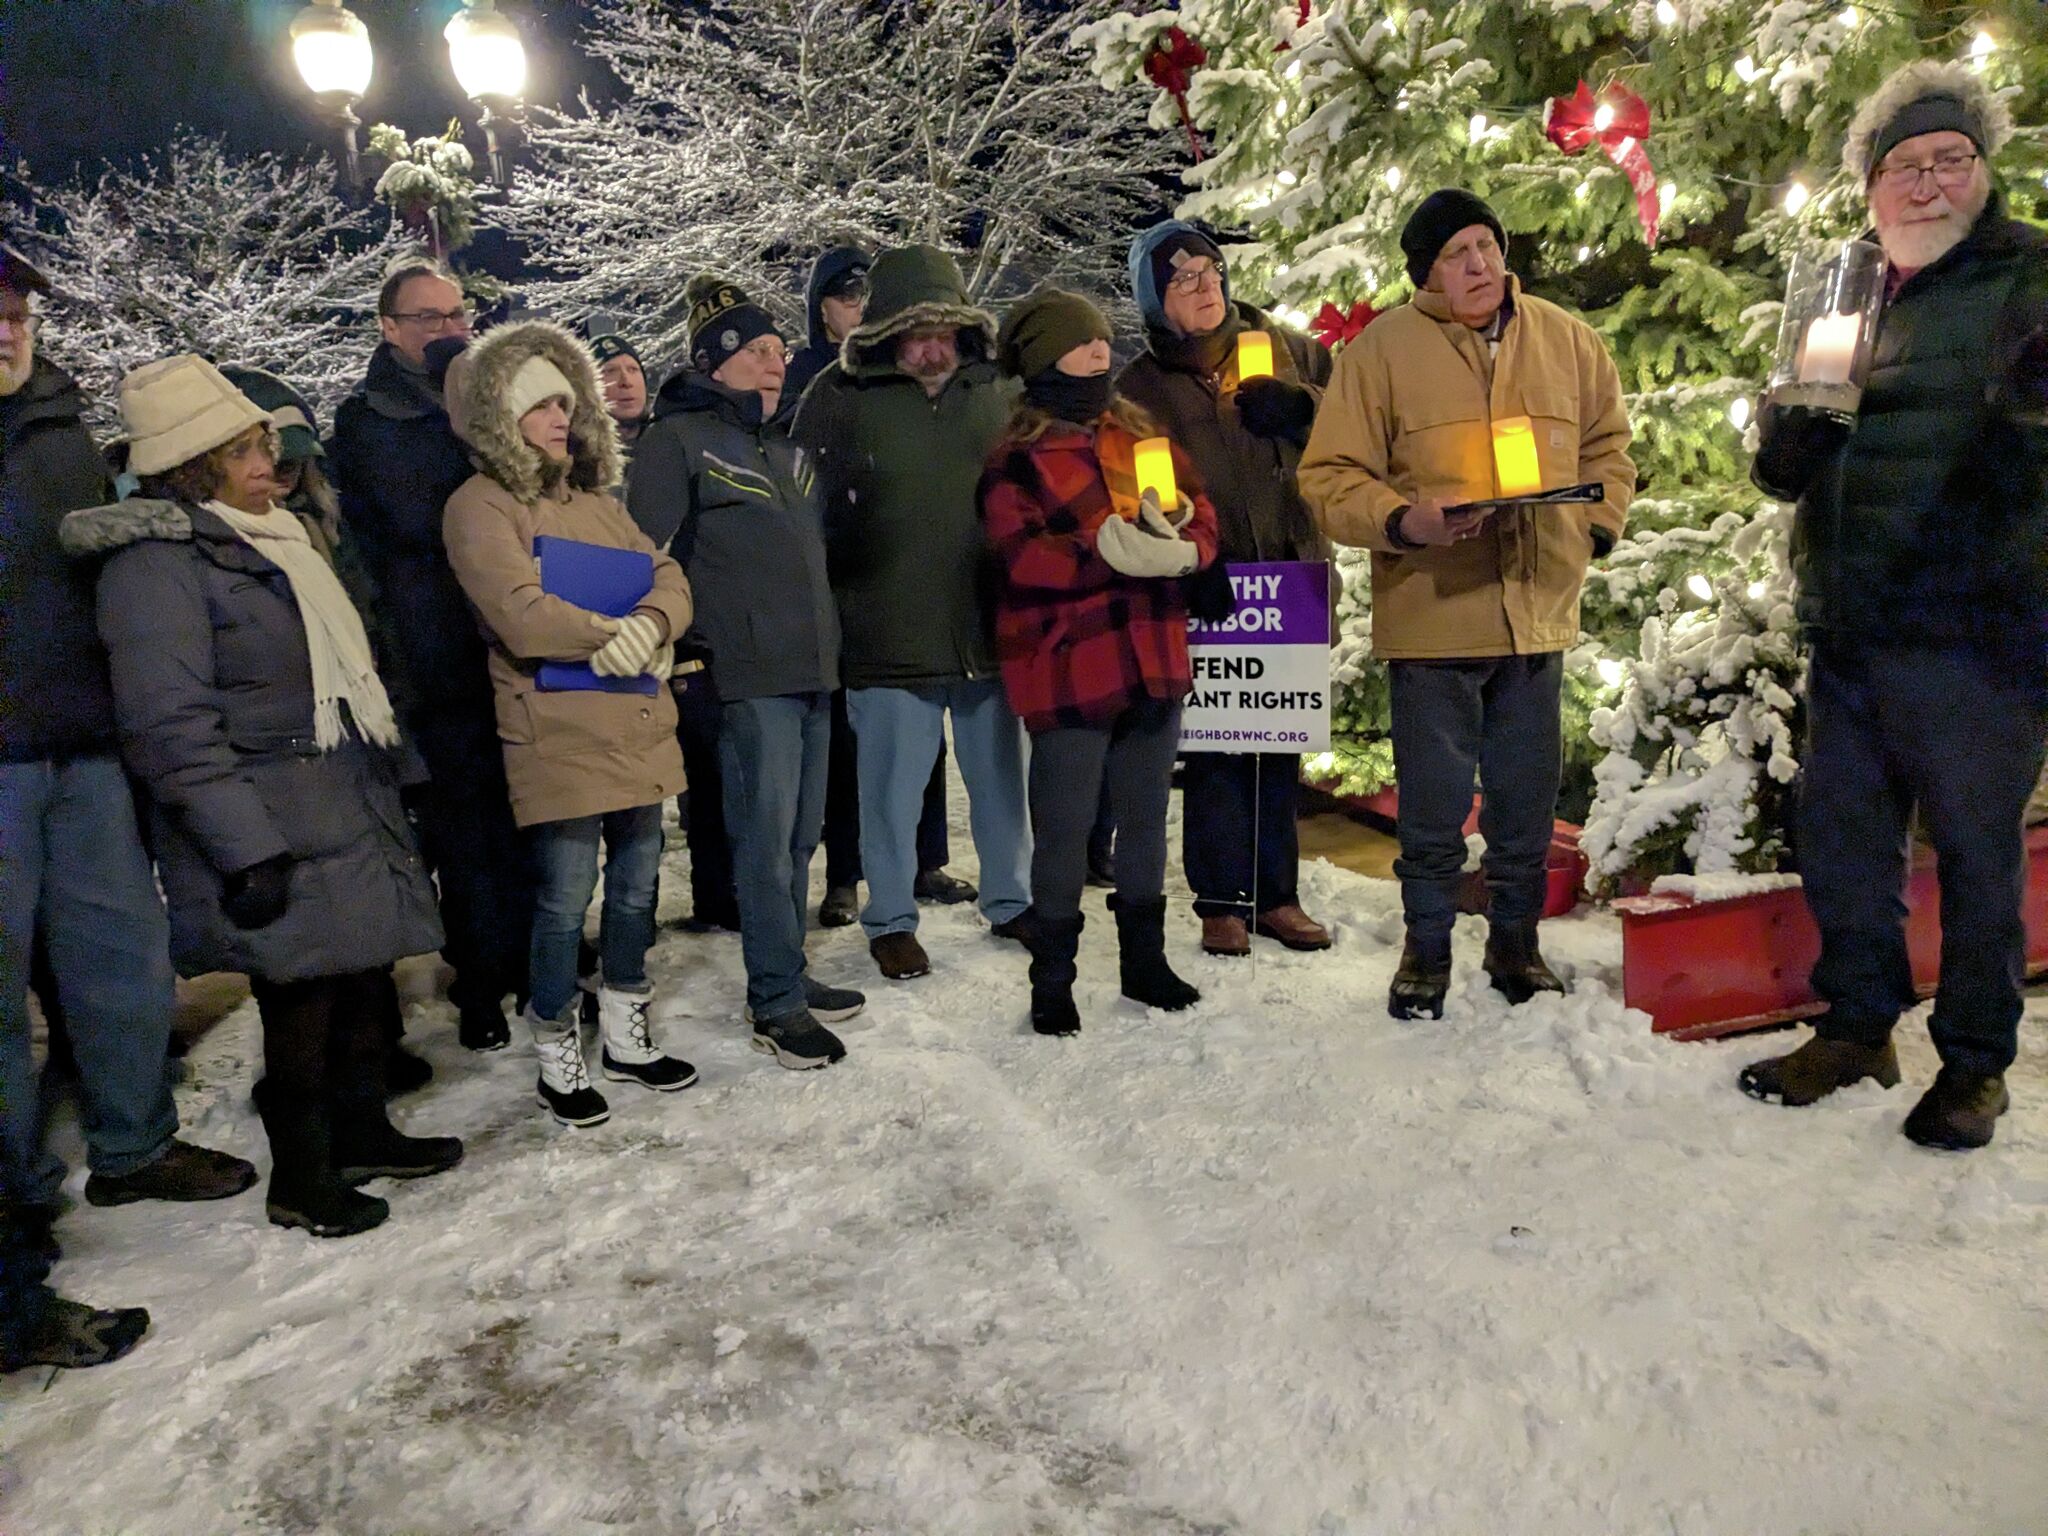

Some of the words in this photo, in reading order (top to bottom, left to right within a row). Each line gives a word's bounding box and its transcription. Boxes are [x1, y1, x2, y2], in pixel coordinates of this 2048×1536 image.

[1229, 575, 1283, 600] THY
[1192, 657, 1264, 680] FEND
[1187, 691, 1232, 709] ANT
[1239, 691, 1323, 710] RIGHTS
[1184, 729, 1309, 742] EIGHBORWNC.ORG
